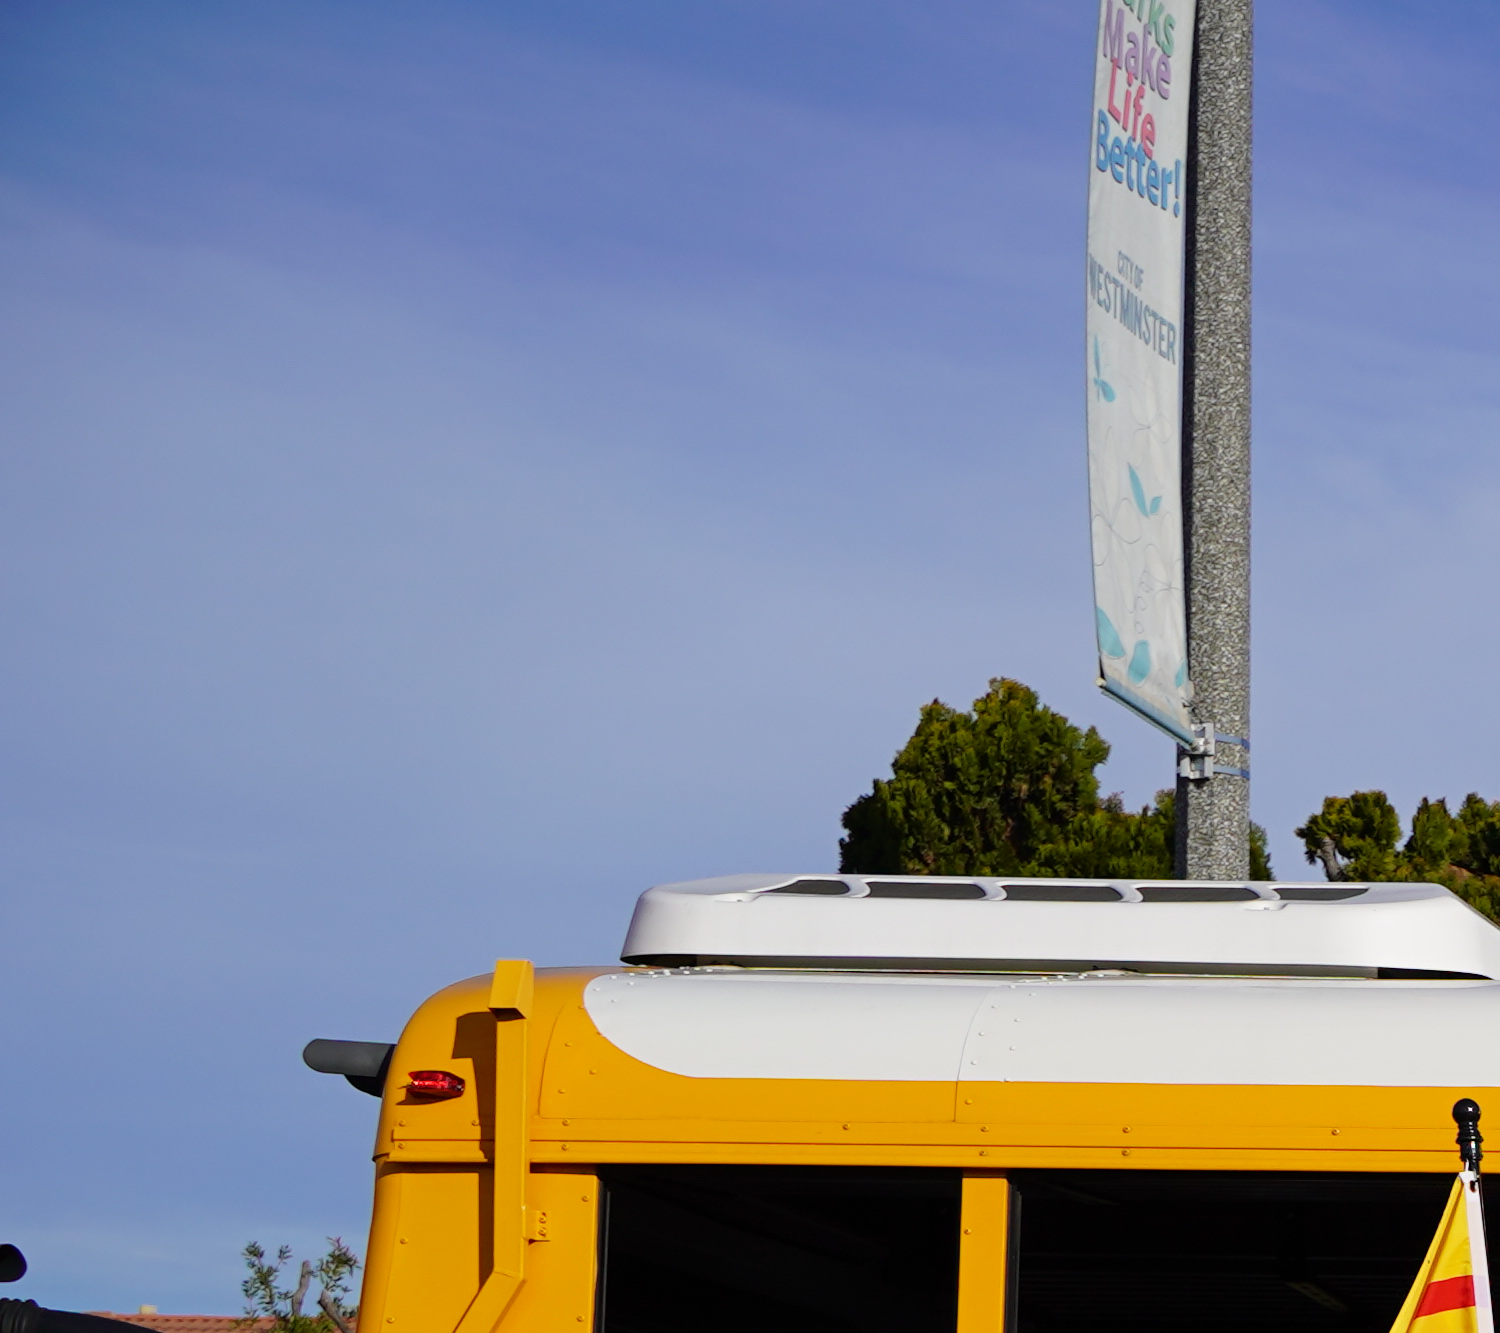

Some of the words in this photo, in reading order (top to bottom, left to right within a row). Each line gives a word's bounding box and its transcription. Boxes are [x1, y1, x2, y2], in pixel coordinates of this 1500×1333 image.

[1103, 0, 1171, 100] Make
[1122, 0, 1176, 58] rks
[1108, 57, 1156, 160] Life
[1096, 108, 1182, 218] Better!
[1088, 253, 1176, 365] WESTMINSTER
[1118, 250, 1134, 284] CITY
[1134, 264, 1144, 292] OF
